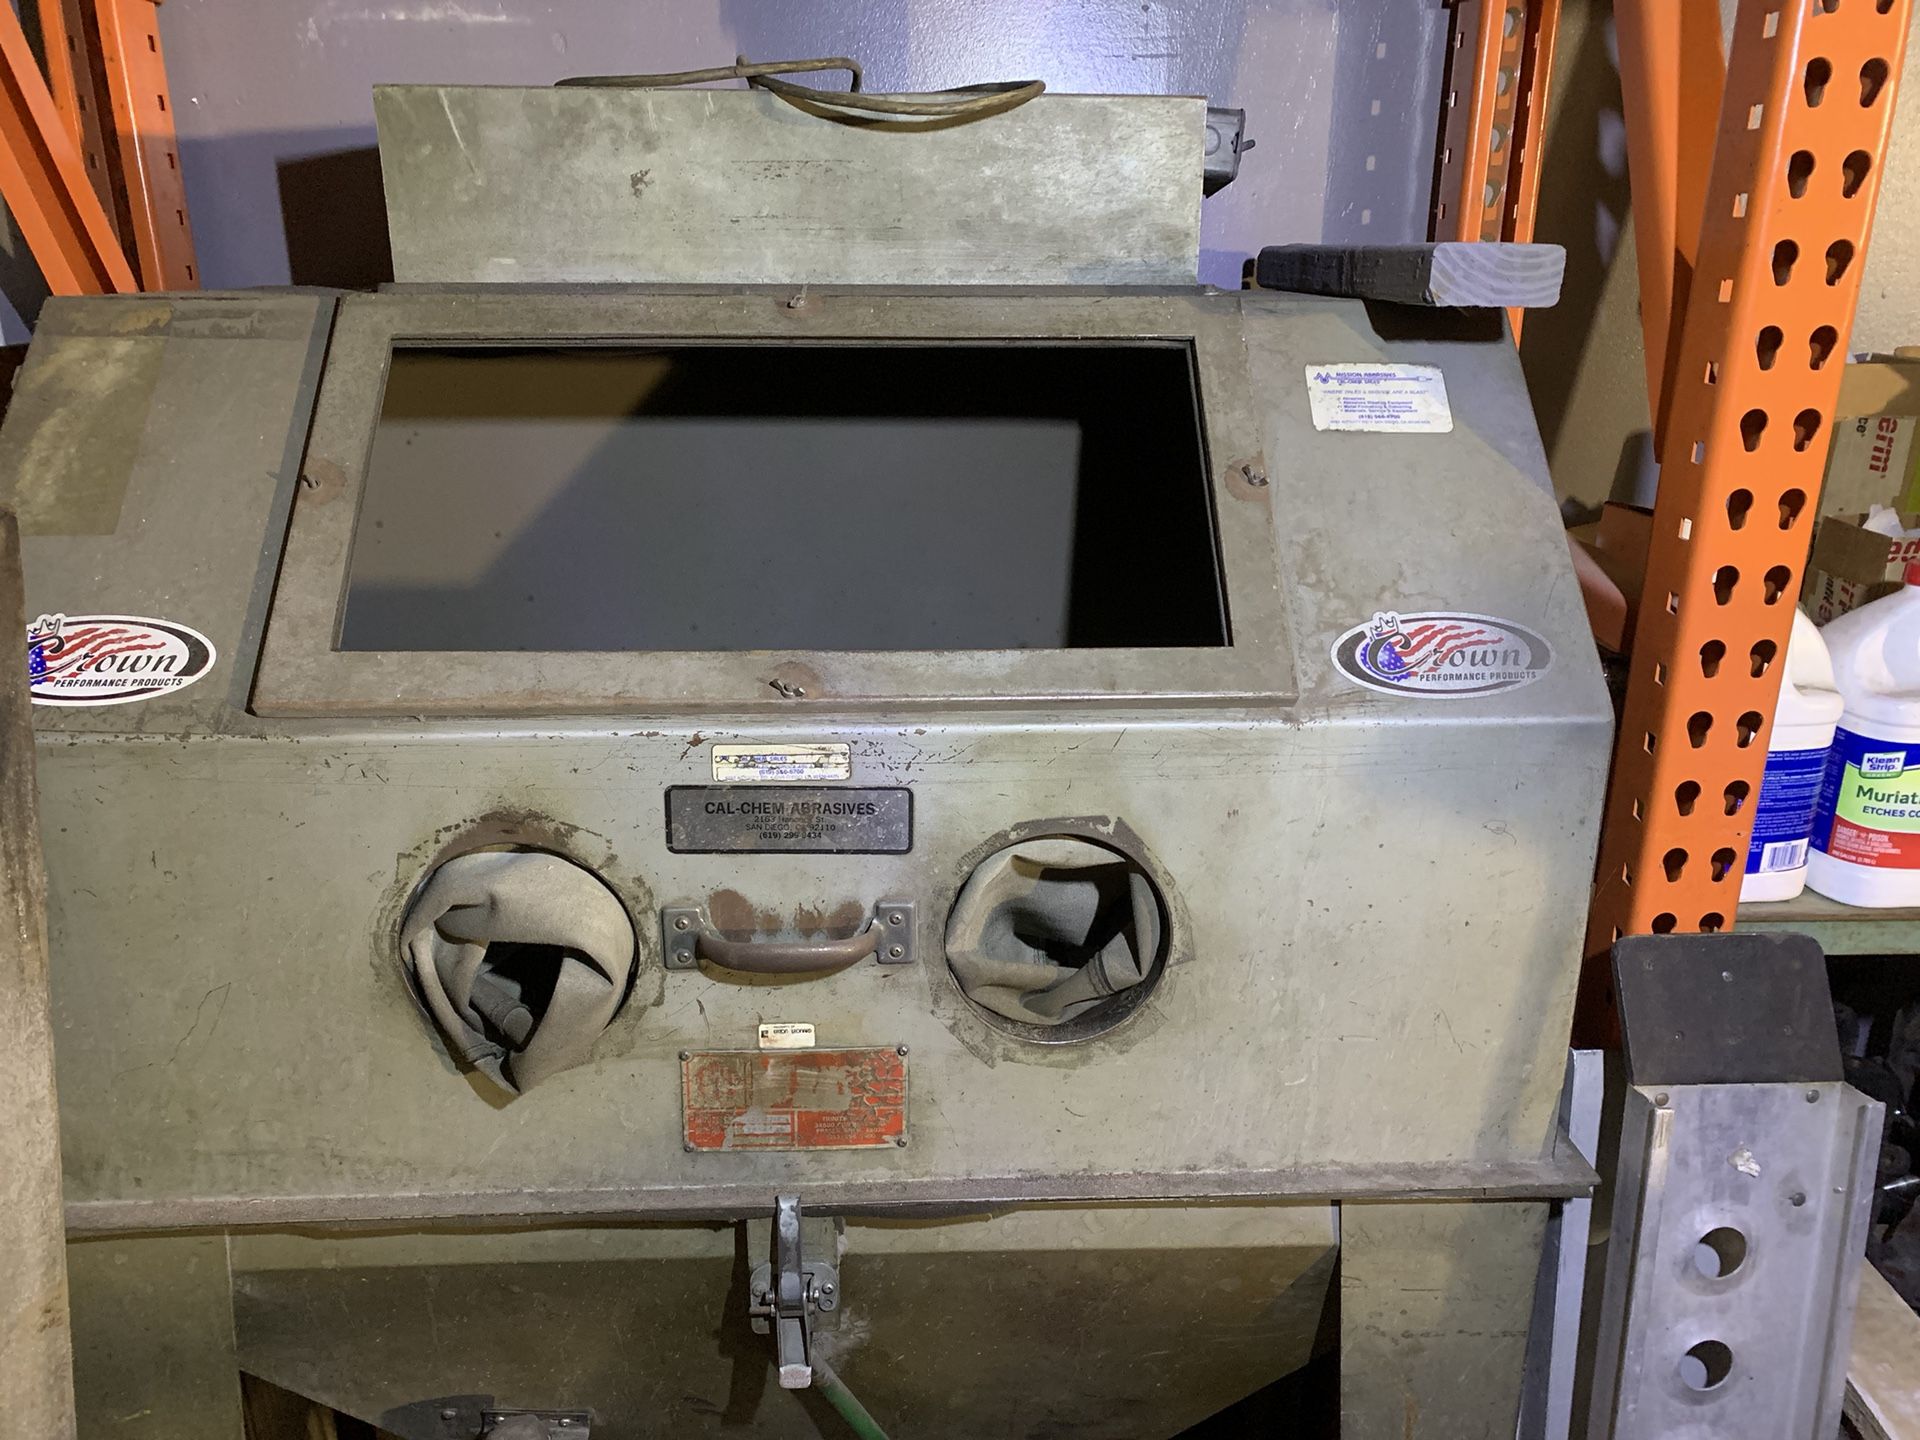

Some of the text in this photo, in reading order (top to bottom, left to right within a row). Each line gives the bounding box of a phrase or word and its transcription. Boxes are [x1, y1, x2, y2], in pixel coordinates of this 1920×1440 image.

[1368, 633, 1520, 676] Crown
[1419, 671, 1537, 682] PERFORMANCE PRODUCTS
[54, 677, 184, 688] PERFORMANCE PRODUCTS
[1866, 756, 1900, 765] Klean
[1869, 764, 1896, 772] Strip
[1856, 785, 1920, 805] Muriat
[705, 802, 875, 815] CAL-CHEM ABRASIVES
[1863, 805, 1906, 818] ETCHES
[759, 832, 781, 840] (619)
